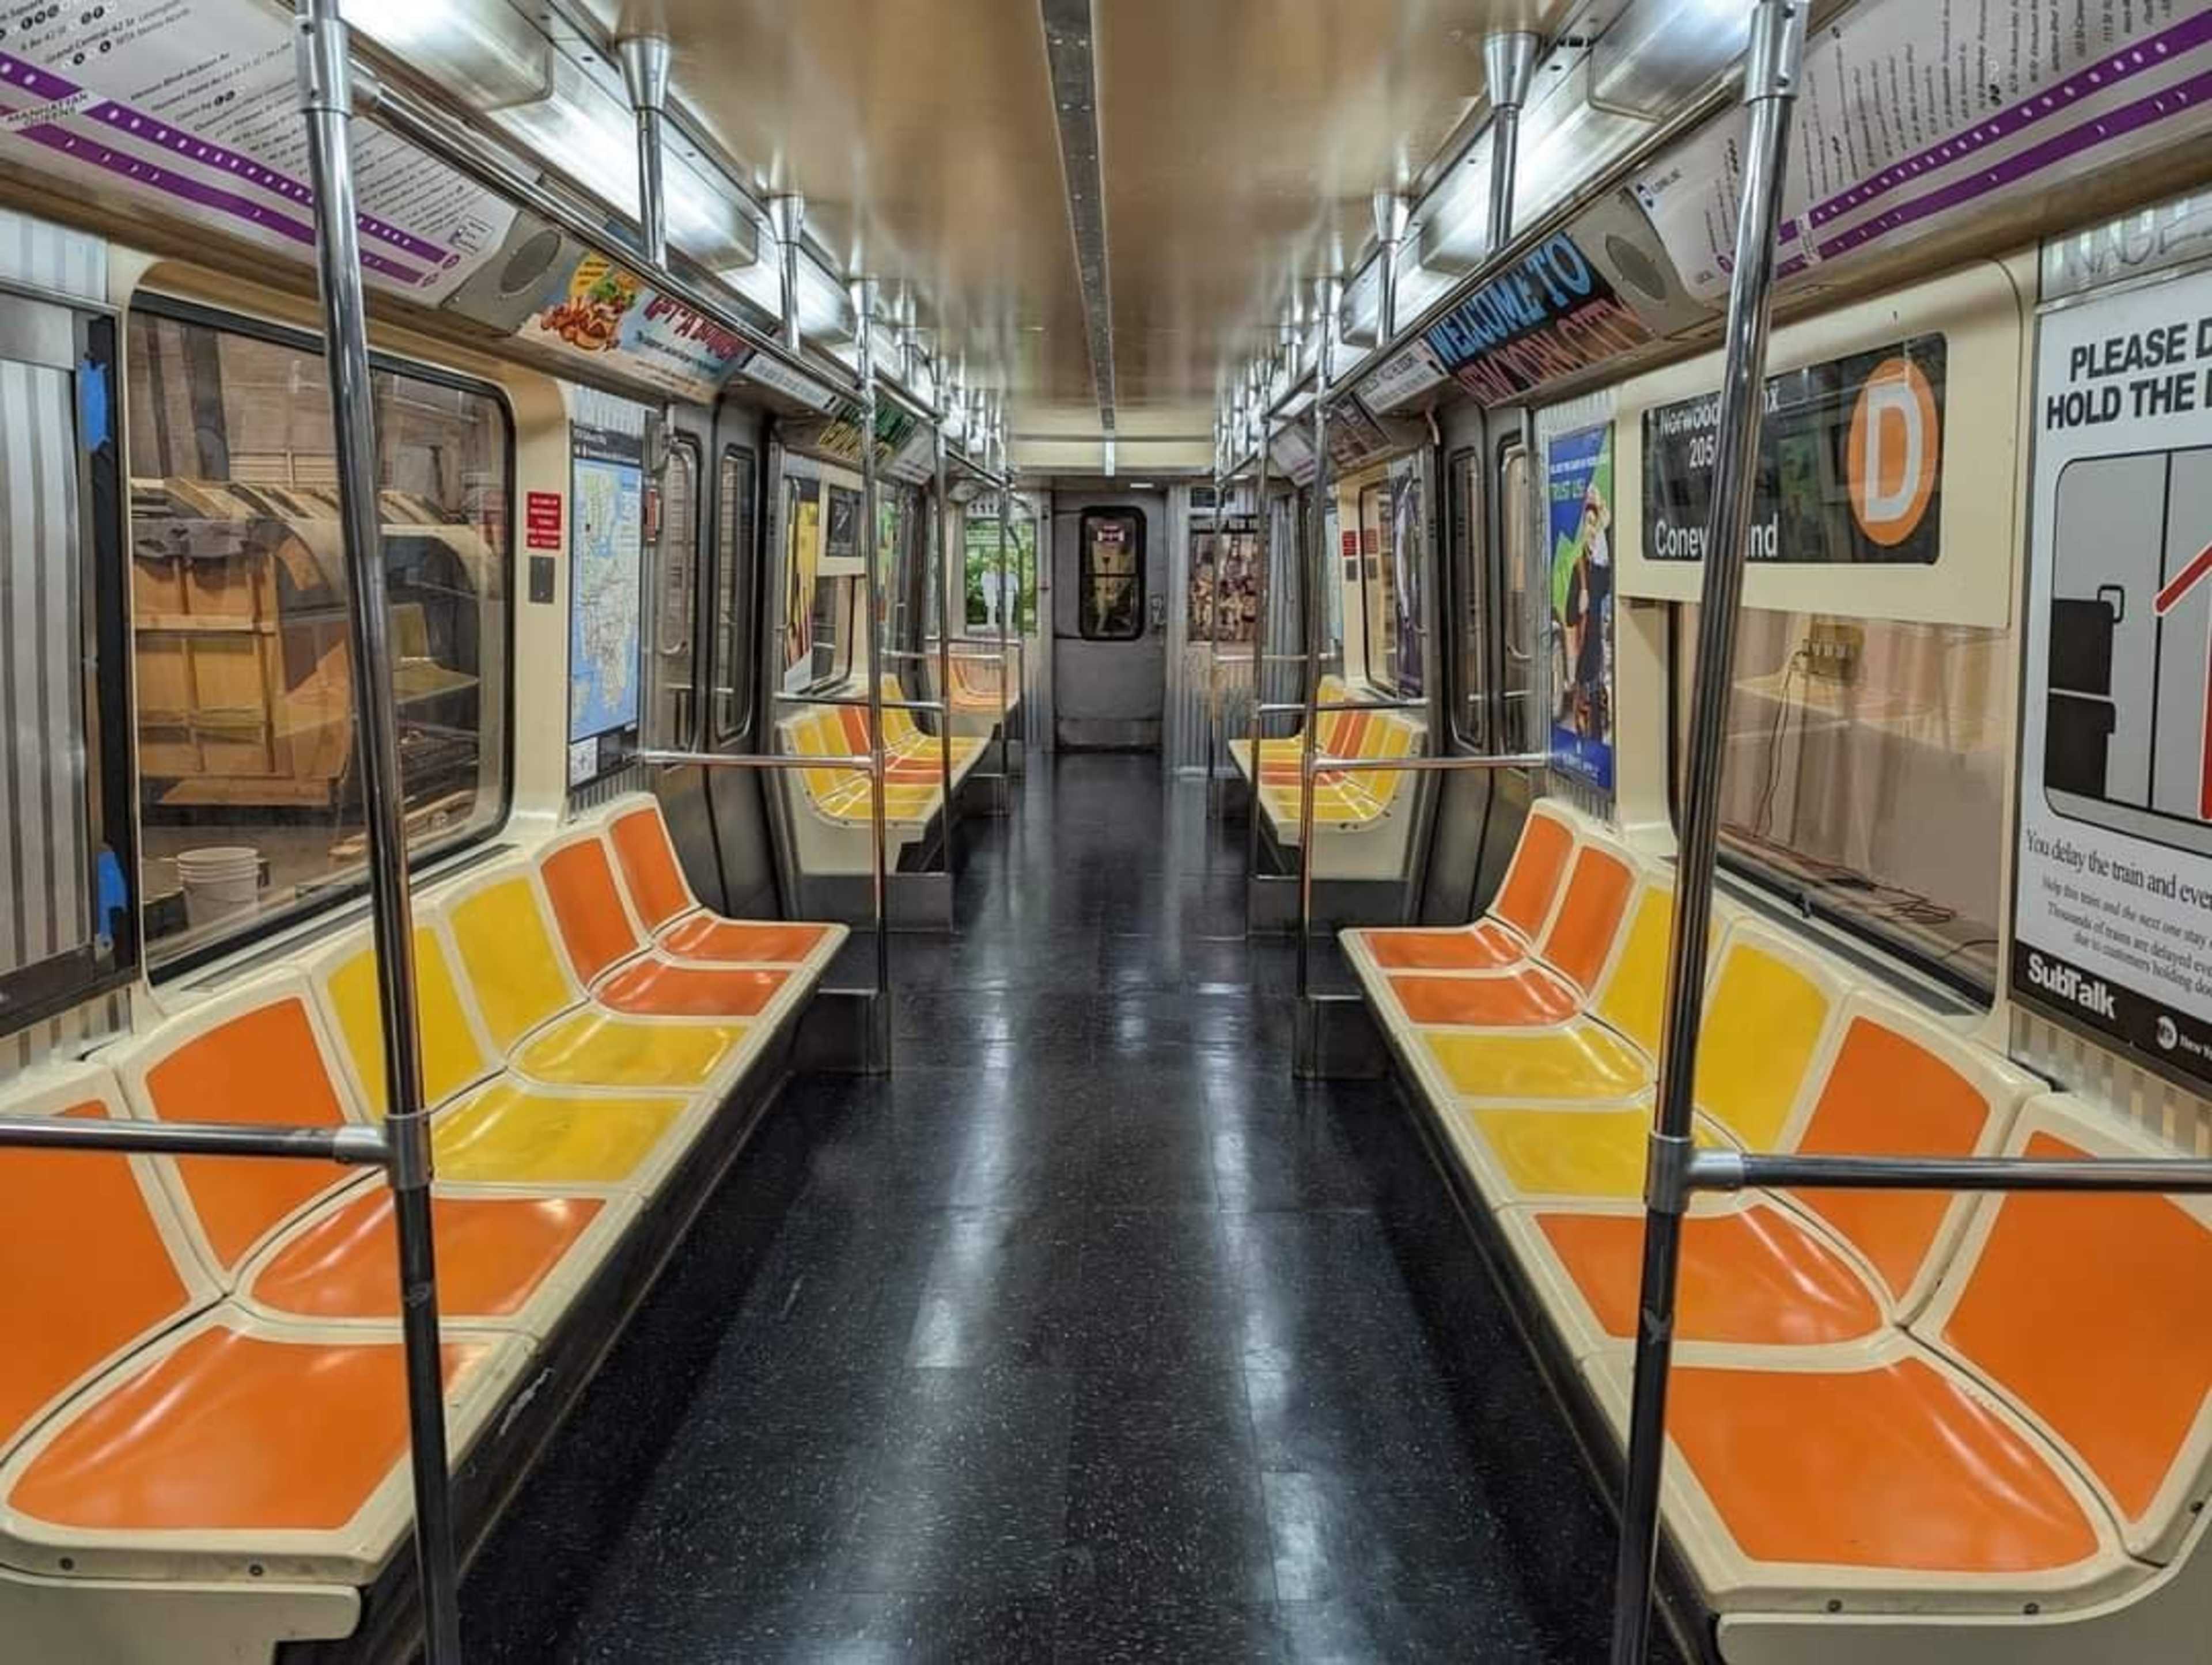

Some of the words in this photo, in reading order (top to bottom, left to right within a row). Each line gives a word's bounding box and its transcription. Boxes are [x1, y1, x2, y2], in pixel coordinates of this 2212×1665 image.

[1426, 263, 1547, 365] WELCOME
[1524, 234, 1591, 307] TO
[1491, 327, 1588, 392] YORK
[1550, 293, 1656, 367] CITY
[2070, 323, 2188, 382] PLEASE
[2047, 386, 2122, 430] HOLD
[2130, 371, 2196, 418] THE
[1689, 434, 1714, 469] 205
[1865, 381, 1923, 524] D
[1654, 519, 1709, 559] Coney
[2027, 828, 2049, 856] You
[2052, 838, 2084, 873] delay
[2089, 849, 2109, 877] the
[2112, 861, 2143, 888] train
[2147, 874, 2176, 899] and
[2028, 953, 2116, 1019] SubTalk
[2153, 959, 2192, 992] holding
